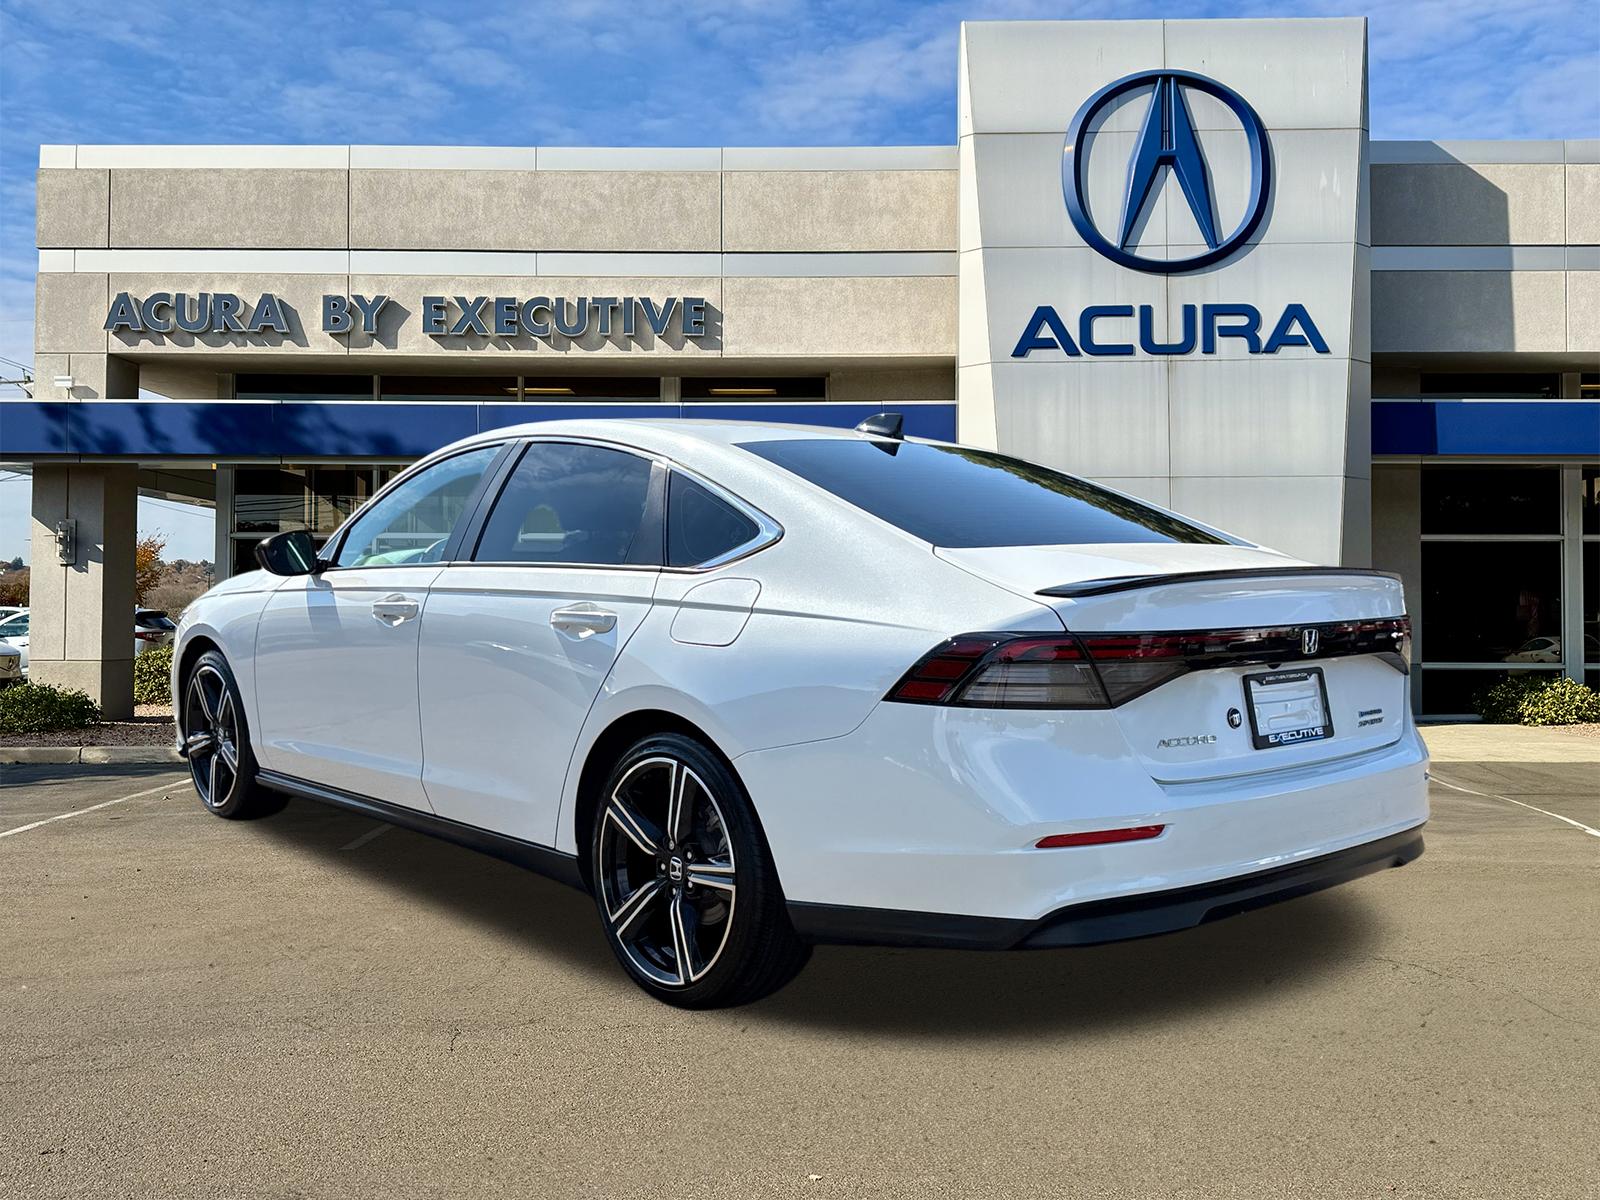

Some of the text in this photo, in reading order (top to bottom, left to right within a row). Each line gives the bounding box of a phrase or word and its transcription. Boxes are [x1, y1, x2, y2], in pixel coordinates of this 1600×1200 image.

[103, 292, 706, 338] ACURA BY EXECUTIVE
[1010, 303, 1331, 357] ACURA
[1268, 727, 1324, 743] EXECUTIVE
